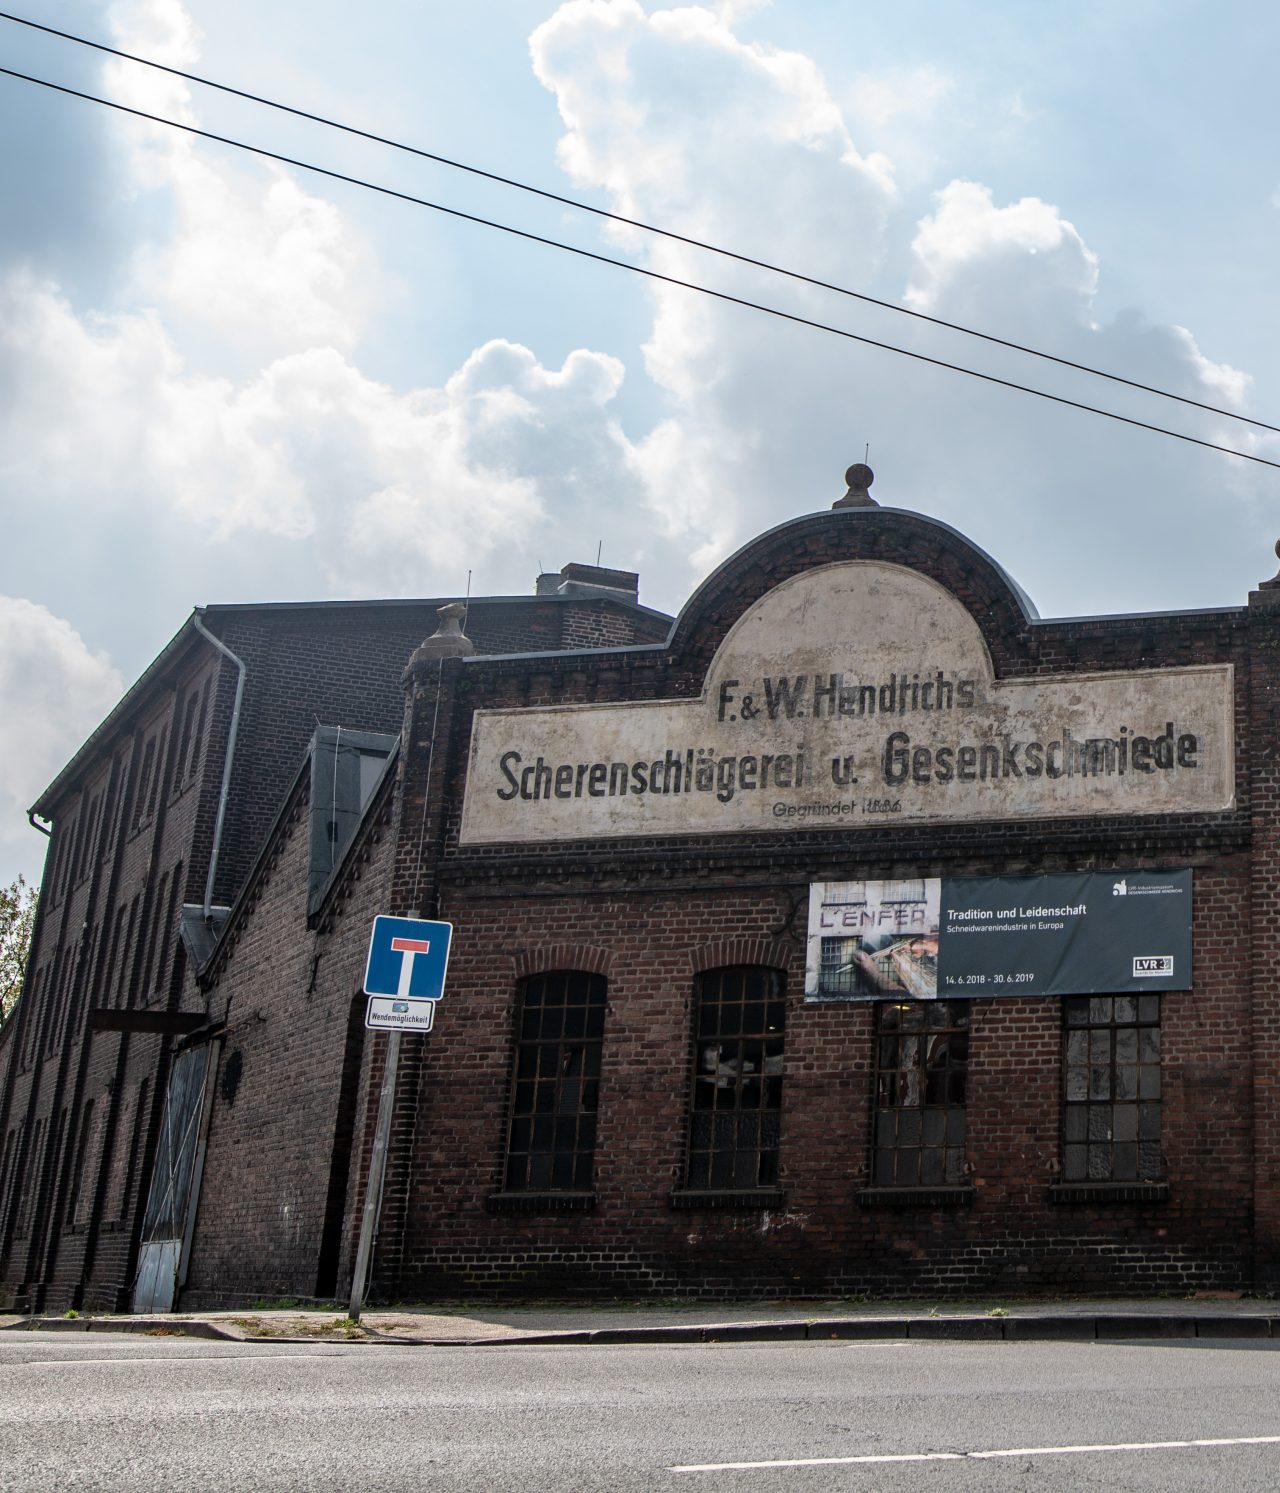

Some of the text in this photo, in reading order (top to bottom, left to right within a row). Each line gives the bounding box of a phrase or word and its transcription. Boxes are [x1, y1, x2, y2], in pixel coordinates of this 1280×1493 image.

[497, 722, 1199, 803] Scherenschlägerei u. Gesenkschmiede
[772, 800, 857, 820] Gegründet
[947, 904, 1087, 920] Tradition und Leidenschaft
[946, 923, 1028, 933] Schneidwarenindustrie
[1038, 920, 1064, 931] Europa
[1136, 960, 1158, 970] LVR
[372, 1012, 428, 1023] Wendemöglichkeit
